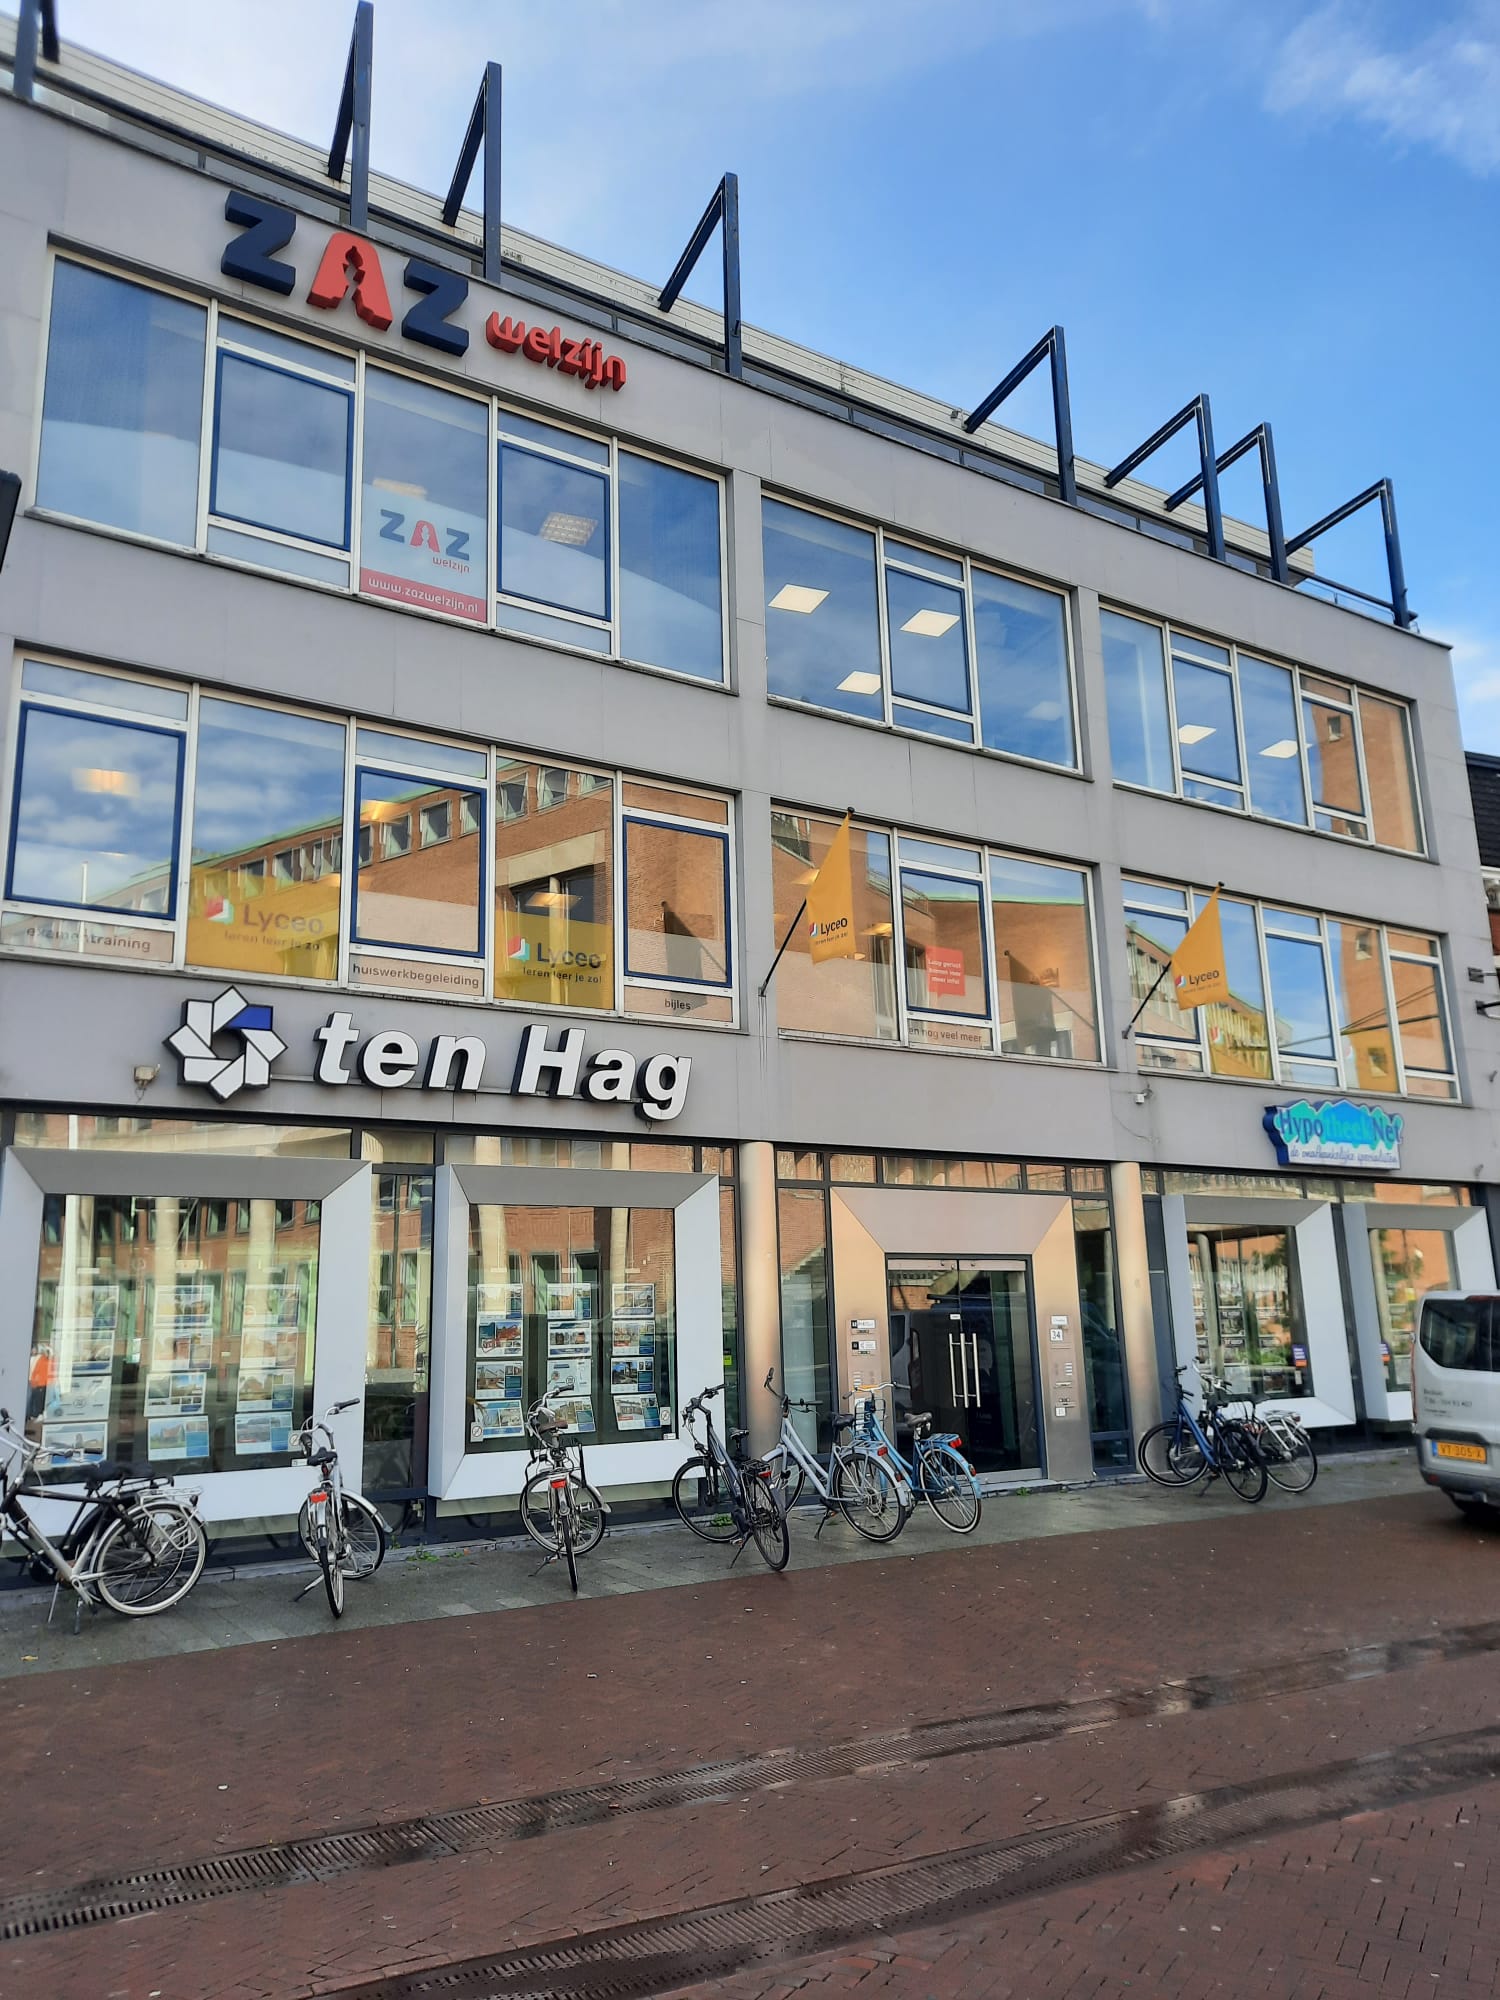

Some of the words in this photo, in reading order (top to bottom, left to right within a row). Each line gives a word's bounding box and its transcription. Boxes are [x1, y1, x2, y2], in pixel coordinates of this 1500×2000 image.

[221, 190, 469, 357] ZAZ
[485, 310, 627, 393] welzijn
[380, 509, 470, 561] ZAZ
[432, 556, 470, 574] welzijn
[368, 577, 478, 613] www.zazwelzijn.nl
[243, 903, 324, 935] Lyceo
[821, 917, 848, 937] Lyceo
[537, 942, 603, 969] Lyceo
[353, 964, 479, 989] huiswerkbegeleiding
[1189, 969, 1220, 986] Lyceo
[664, 998, 691, 1011] bijles
[909, 1027, 919, 1036] en
[922, 1028, 939, 1039] nog
[940, 1030, 958, 1040] veel
[313, 1011, 488, 1091] ten
[512, 1024, 692, 1123] Hag
